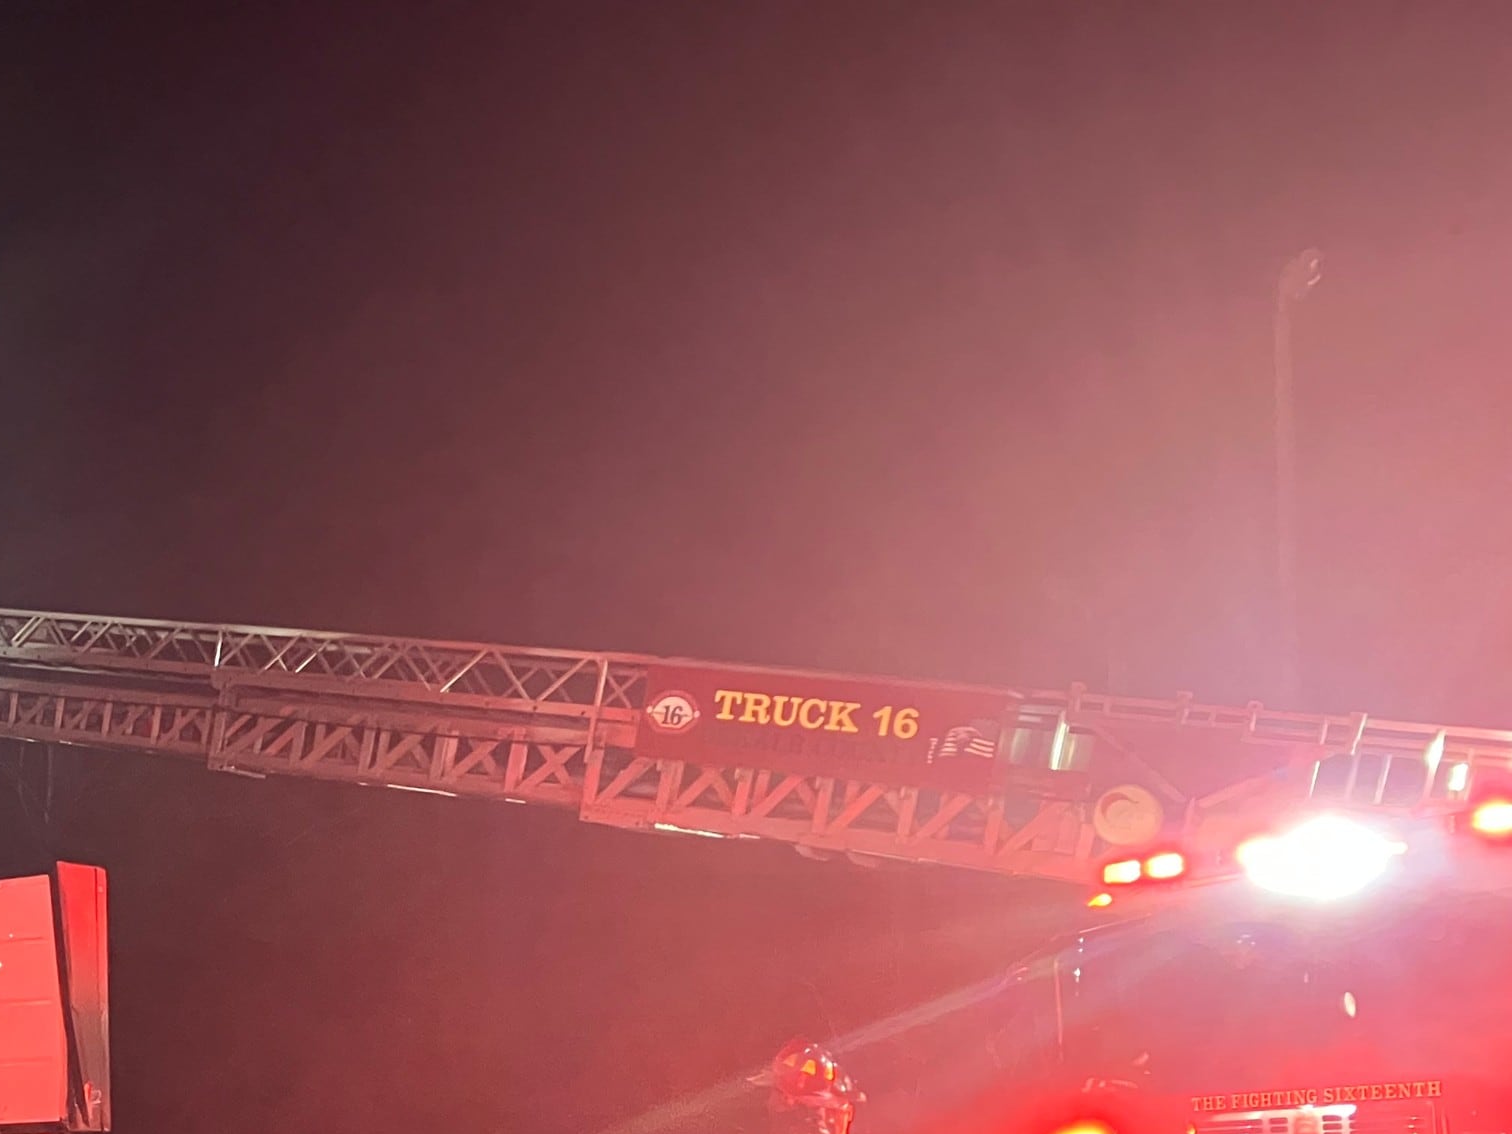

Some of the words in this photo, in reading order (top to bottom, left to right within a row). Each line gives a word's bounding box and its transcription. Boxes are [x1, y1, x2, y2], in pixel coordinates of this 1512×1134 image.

[662, 705, 683, 726] 16
[714, 689, 862, 733] TRUCK
[872, 705, 920, 739] 16
[1191, 1096, 1226, 1112] THE
[1231, 1088, 1318, 1110] FIGHTING
[1323, 1080, 1442, 1104] SIXTEENTH
